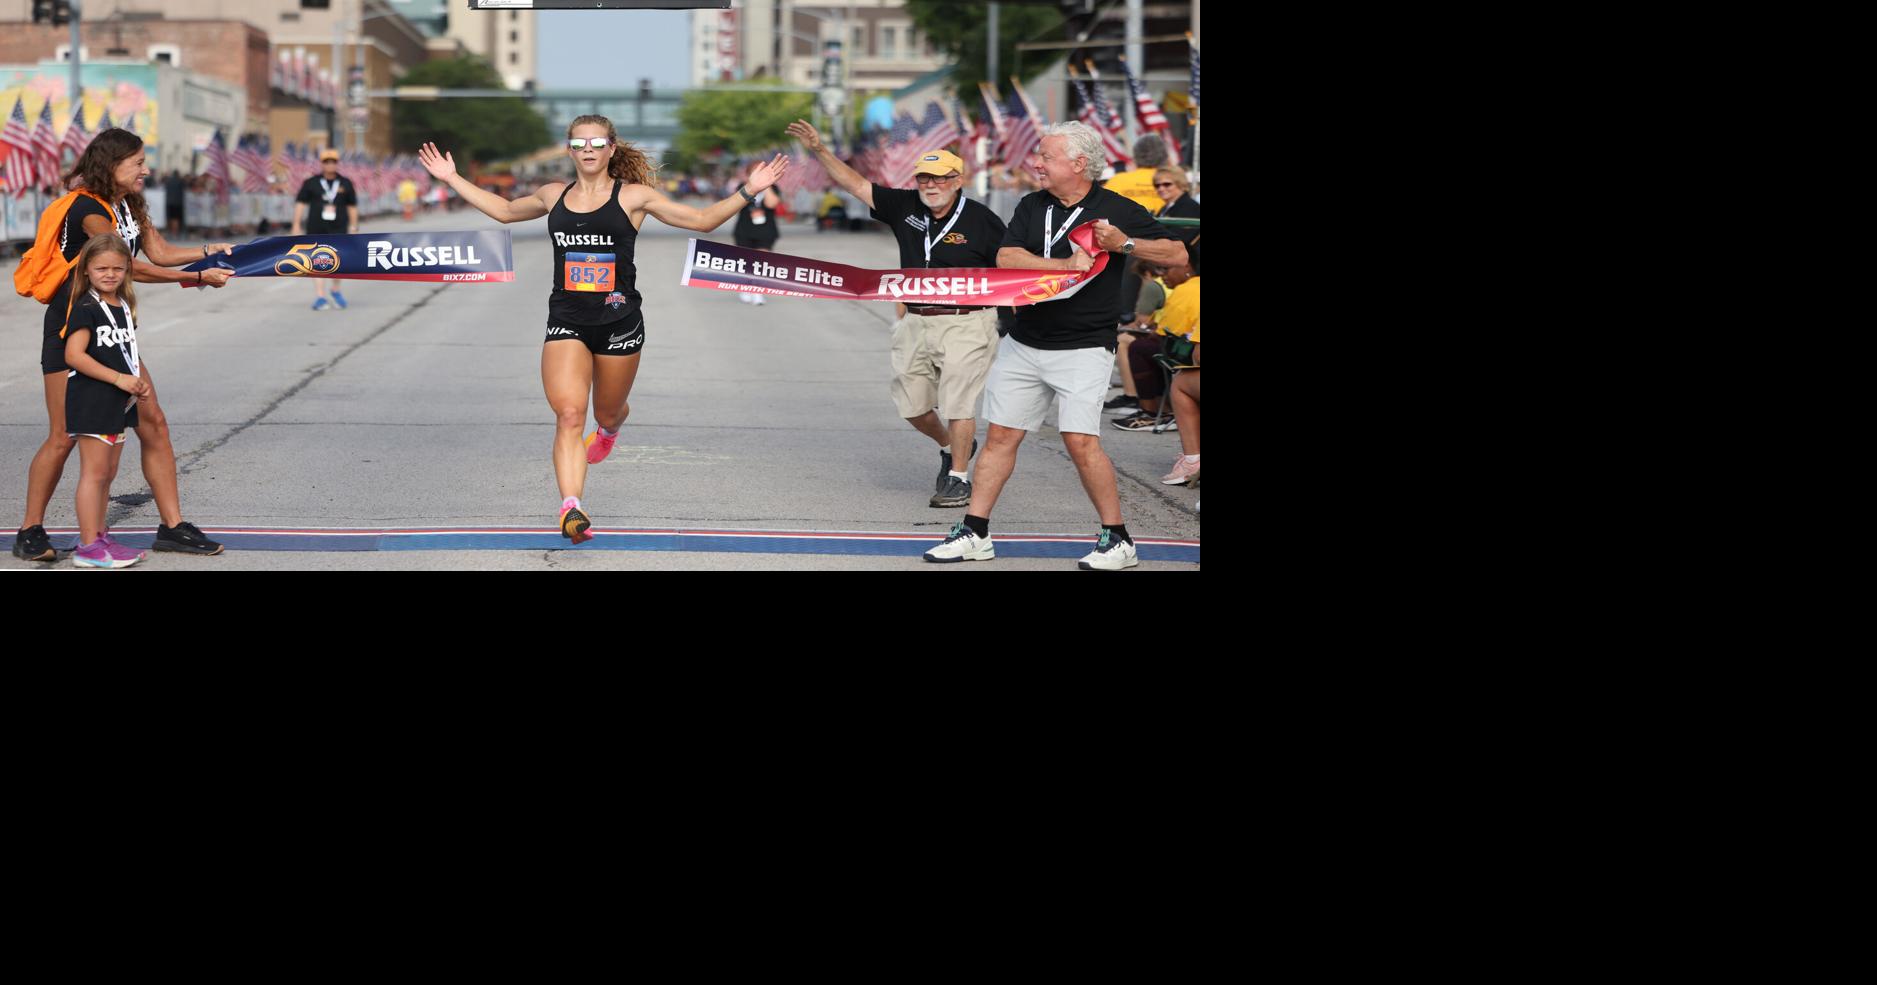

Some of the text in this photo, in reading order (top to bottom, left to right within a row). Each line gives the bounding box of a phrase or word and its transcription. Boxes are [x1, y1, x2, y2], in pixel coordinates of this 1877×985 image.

[553, 231, 615, 248] RUSSELL
[367, 240, 482, 271] RUSSELL
[443, 272, 487, 281] BIX7.COM
[569, 266, 610, 284] 852
[695, 251, 844, 287] Beat the Elite
[717, 282, 740, 290] RUN
[740, 284, 765, 293] WITH
[766, 287, 786, 296] THE
[878, 273, 995, 298] RUSSELL
[547, 327, 579, 337] NIK
[607, 334, 643, 350] PRO
